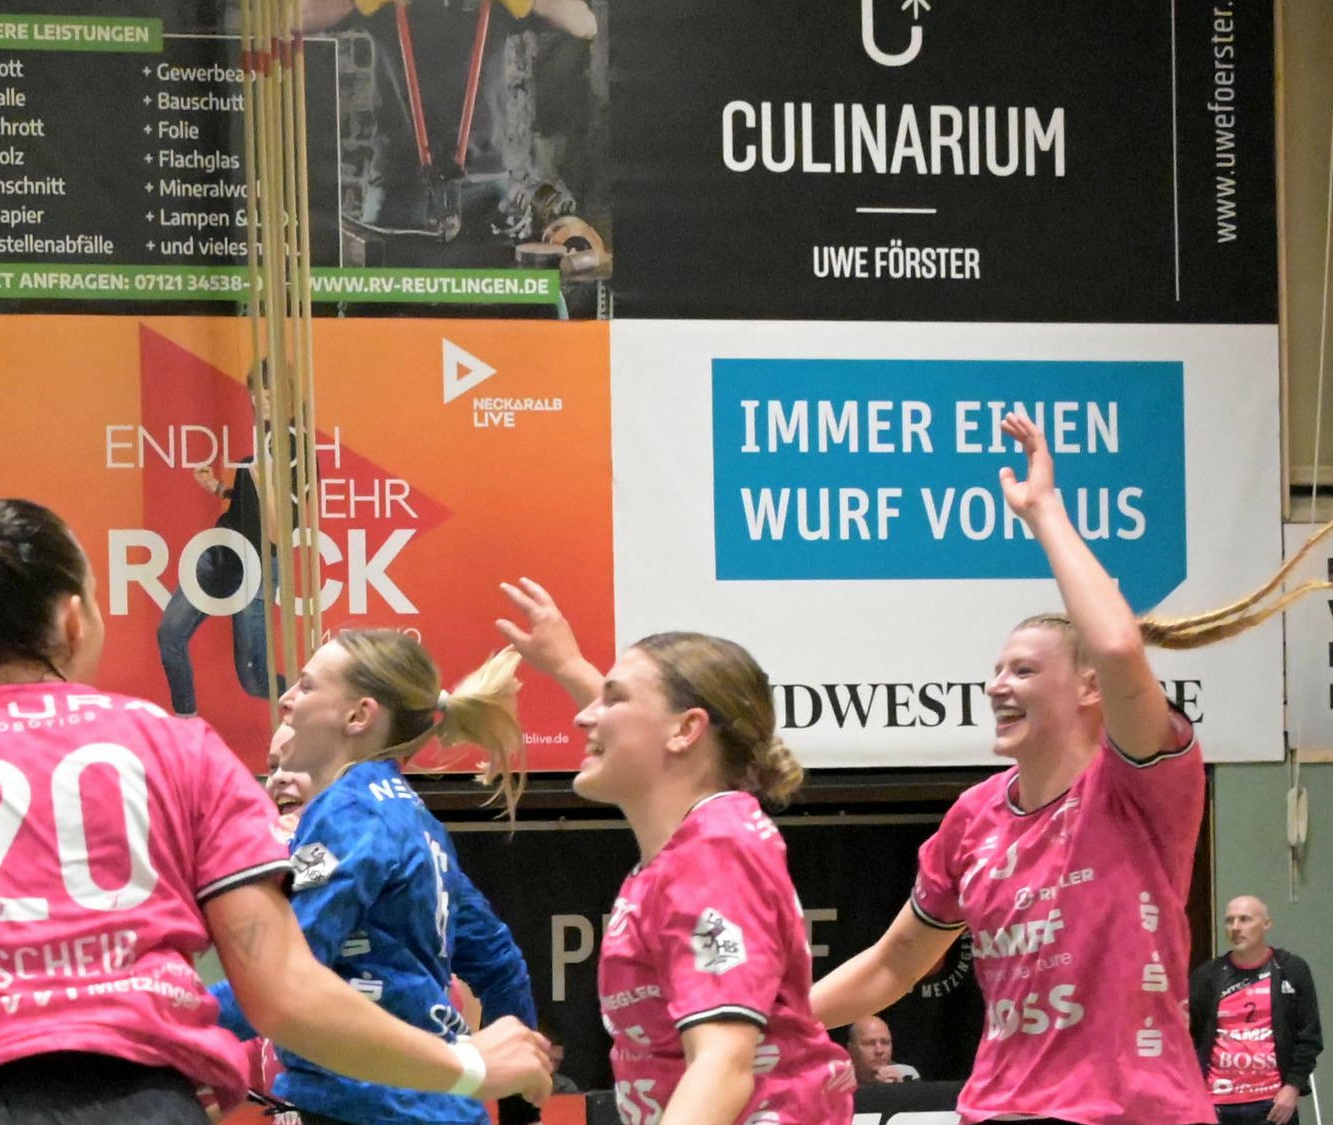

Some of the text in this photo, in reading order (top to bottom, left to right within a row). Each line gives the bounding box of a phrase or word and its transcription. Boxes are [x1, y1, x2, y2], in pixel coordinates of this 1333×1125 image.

[34, 24, 149, 42] LEISTUNGEN
[158, 92, 245, 111] Bauschutt
[159, 121, 198, 139] Folie
[1207, 0, 1238, 243] www.uwefoerster.
[723, 101, 1065, 176] CULINARIUM
[159, 149, 240, 172] Flachglas
[161, 208, 229, 230] Lampen
[161, 236, 193, 255] und
[199, 237, 248, 256] vieles
[814, 239, 980, 279] UWE FÖRSTER
[20, 273, 129, 290] ANFRAGEN:
[135, 274, 182, 290] 07121
[474, 398, 563, 411] NECKARALB
[474, 412, 515, 427] LIVE
[741, 400, 933, 452] IMMER
[292, 479, 418, 518] EHR
[741, 488, 902, 540] WURF
[108, 528, 420, 616] ROCK
[770, 683, 987, 731] DWEST
